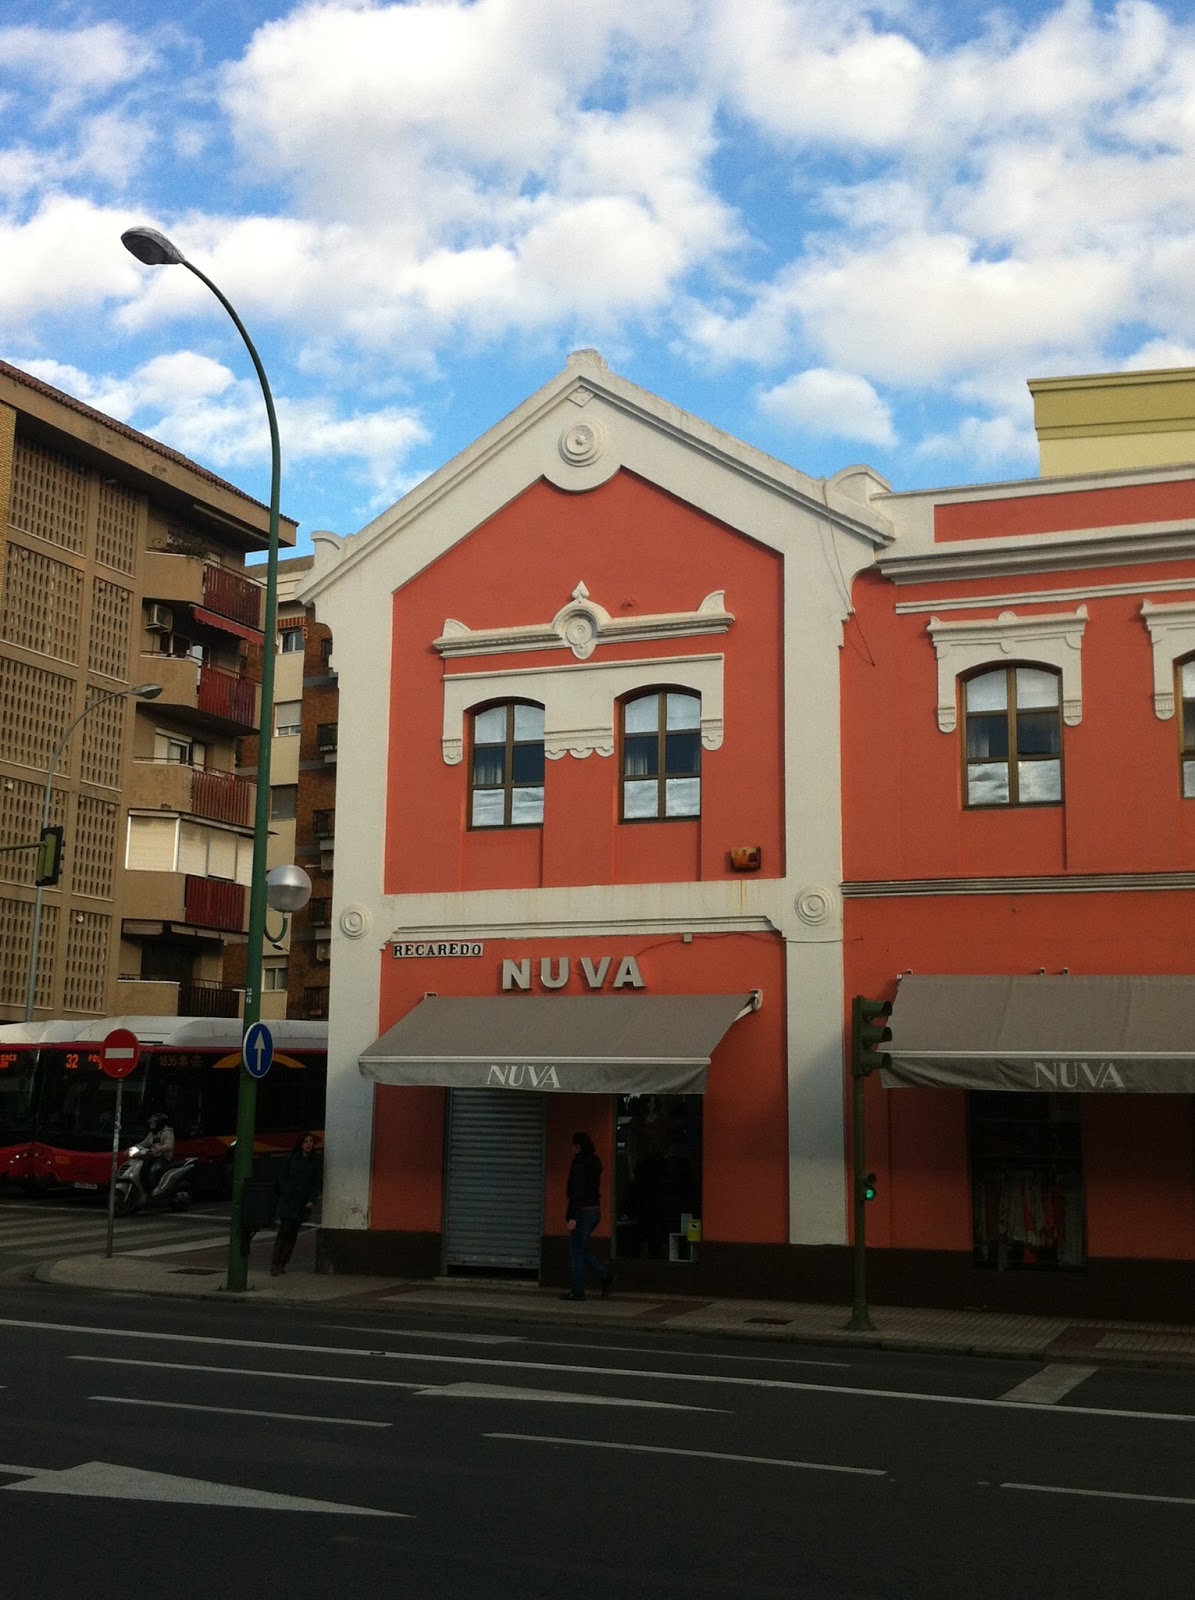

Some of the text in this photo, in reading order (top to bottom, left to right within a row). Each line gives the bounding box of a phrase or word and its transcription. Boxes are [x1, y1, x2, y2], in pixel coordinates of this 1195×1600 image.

[393, 943, 482, 957] RECAREDO
[502, 955, 647, 990] NUVA
[65, 1053, 79, 1068] 32
[486, 1064, 561, 1089] NUVA
[1032, 1061, 1125, 1088] NUVA
